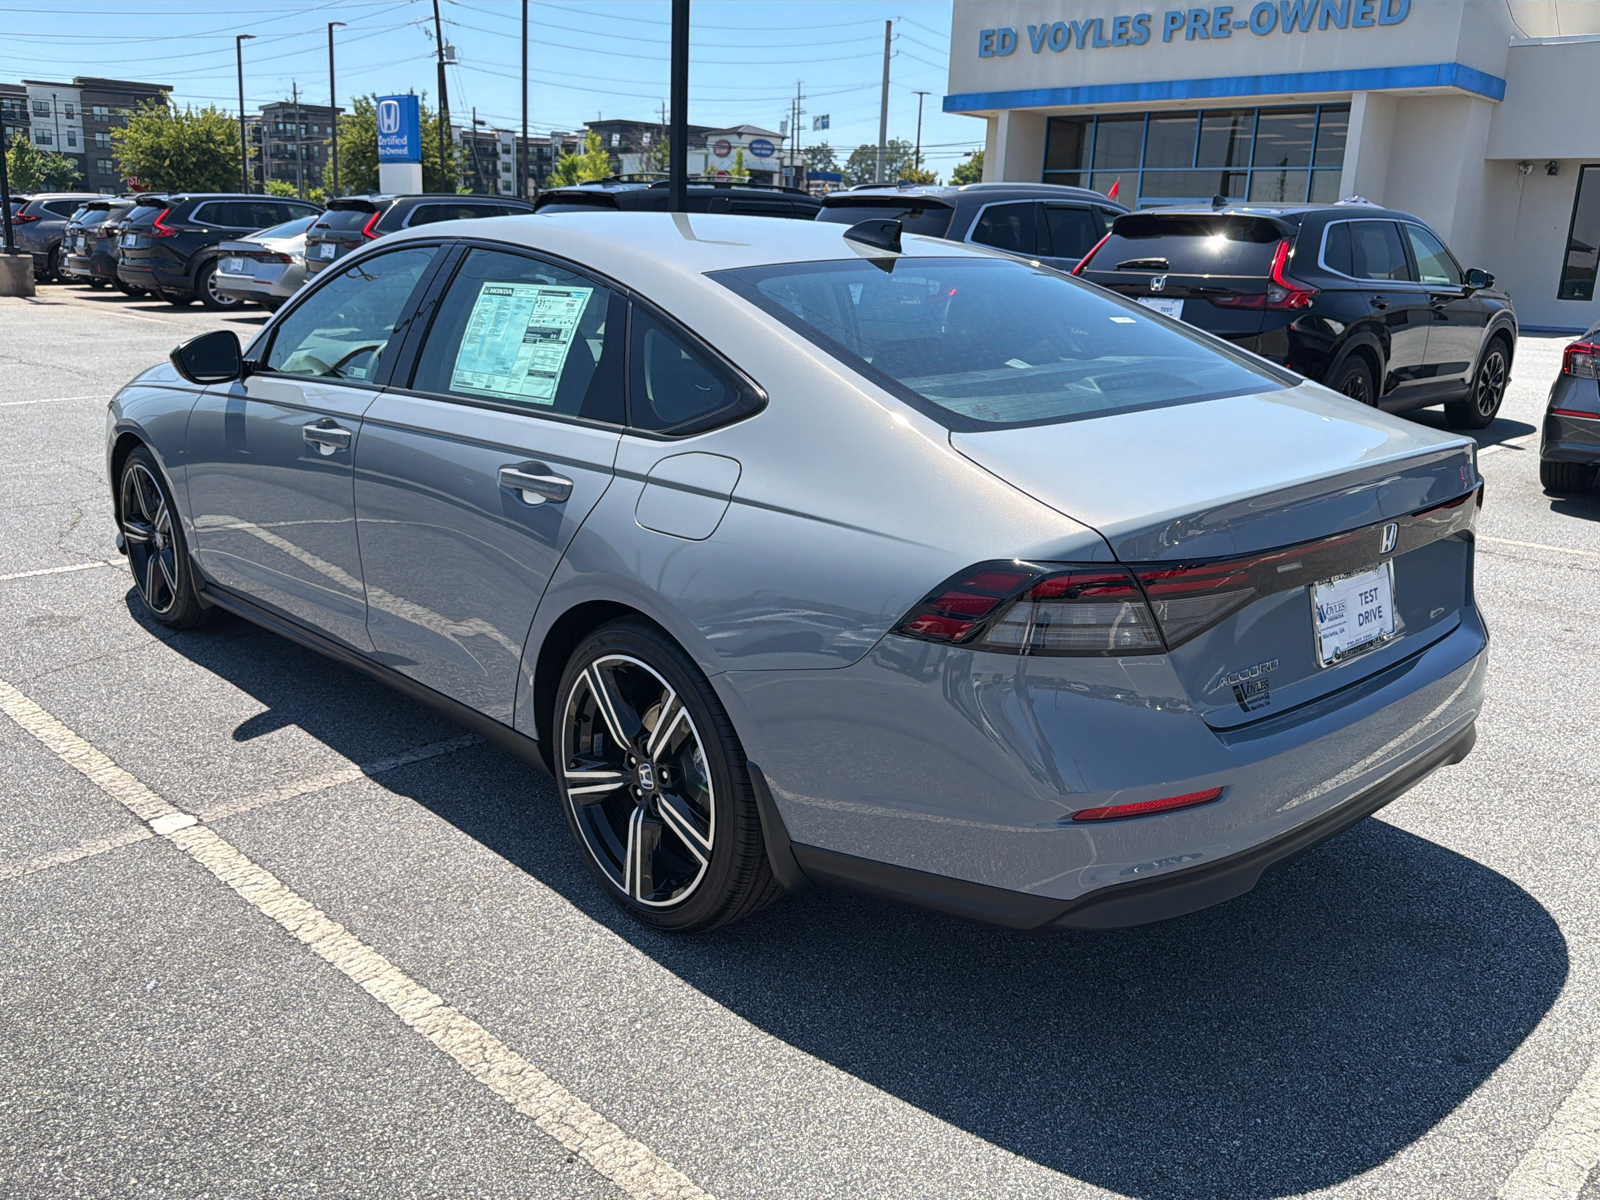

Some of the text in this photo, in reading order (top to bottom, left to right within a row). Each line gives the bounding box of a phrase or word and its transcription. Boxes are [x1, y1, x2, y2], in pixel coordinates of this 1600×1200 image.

[978, 0, 1410, 58] ED VOYLES PRE-OWNED
[1358, 587, 1378, 606] TEST
[1320, 601, 1346, 620] VOYLES
[1357, 605, 1383, 627] DRIVE
[1208, 659, 1280, 695] ACCORD
[1240, 678, 1268, 700] VOYLES
